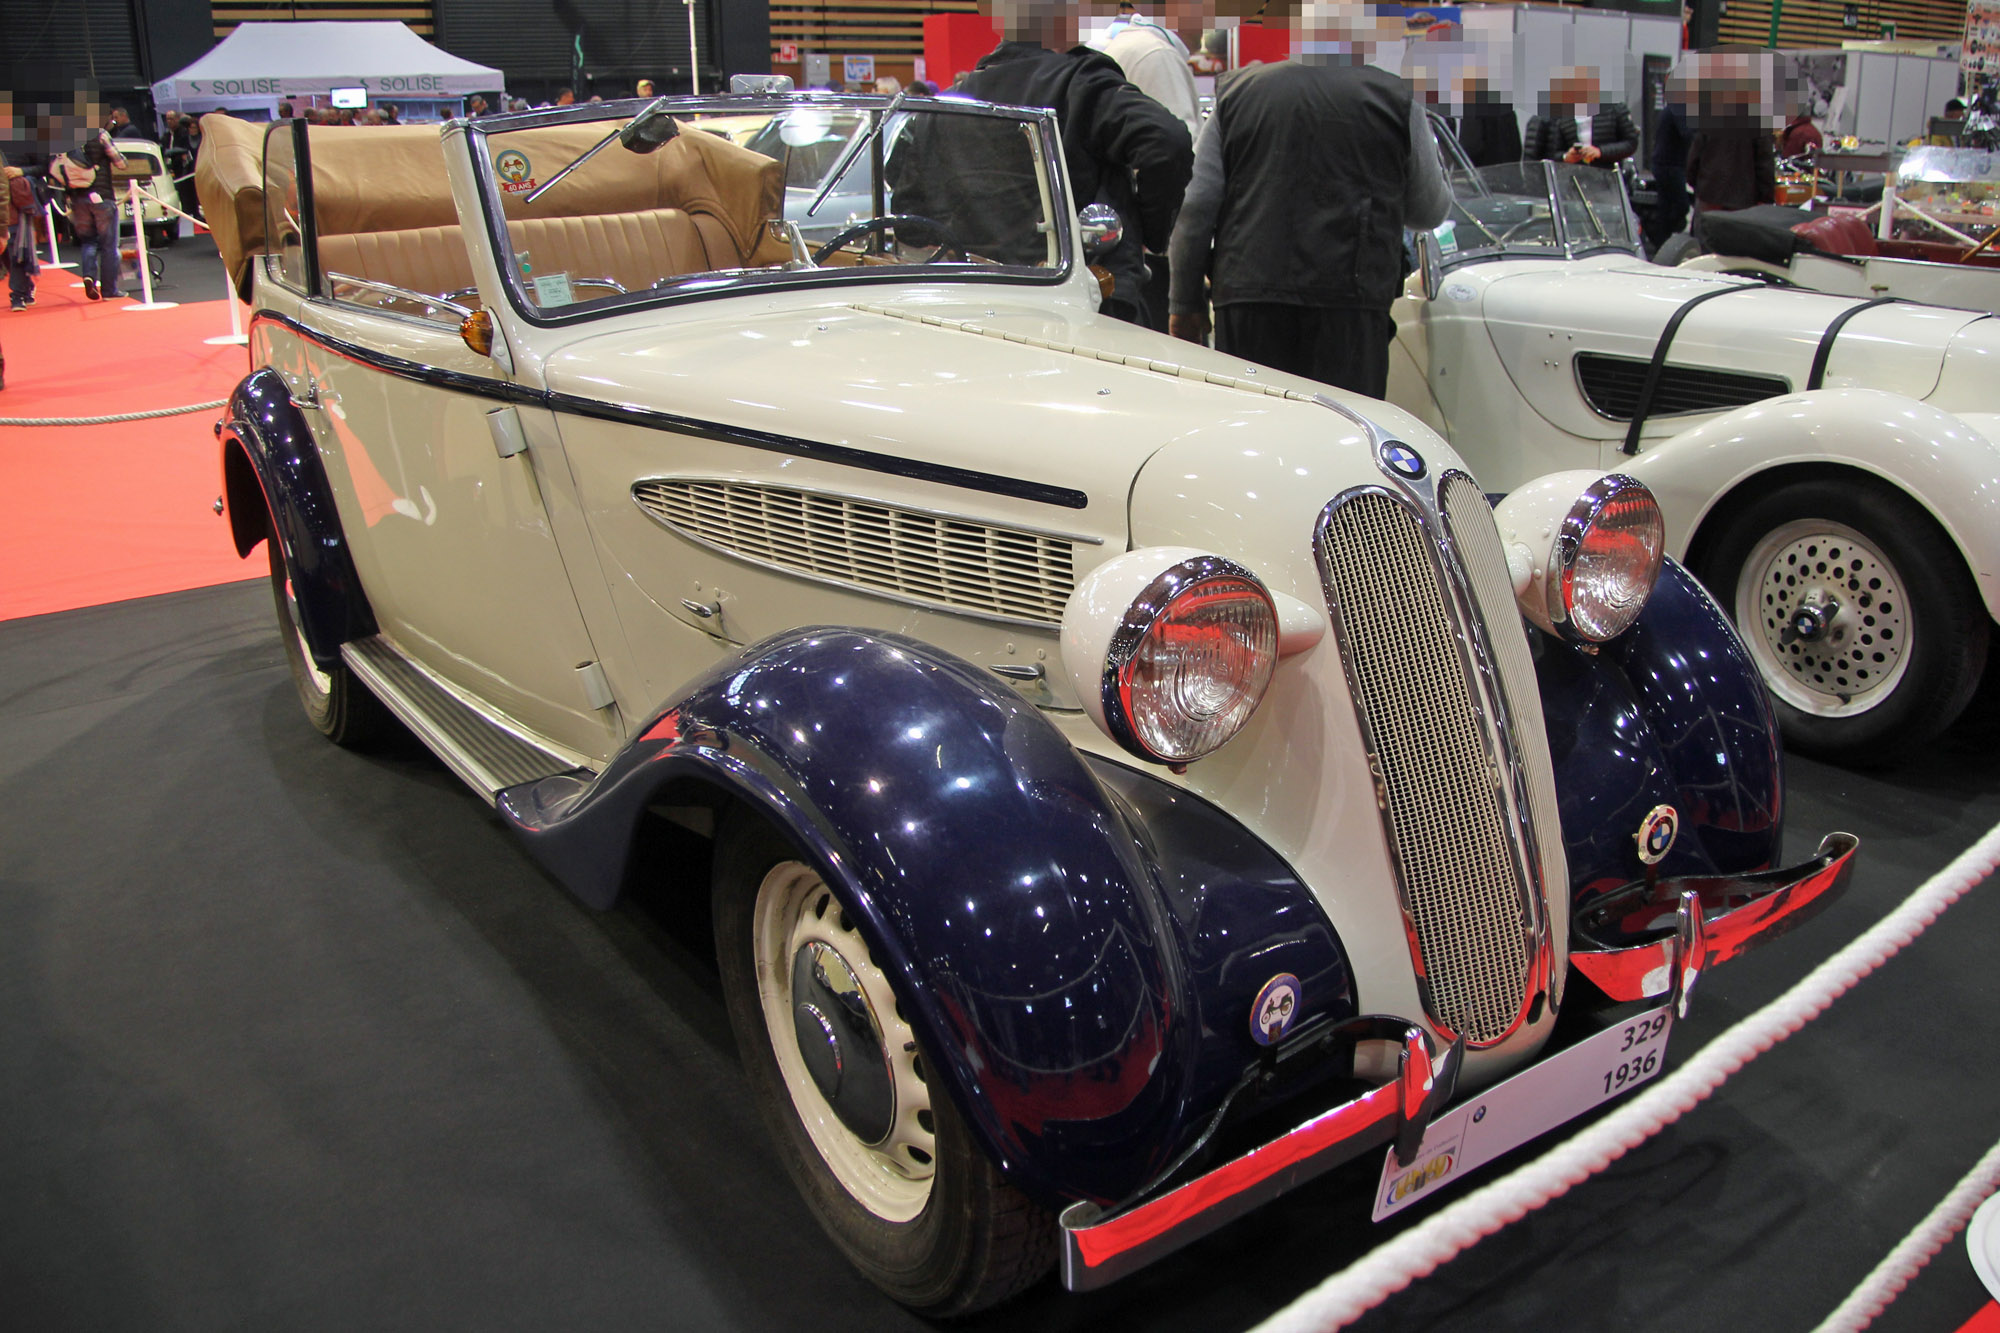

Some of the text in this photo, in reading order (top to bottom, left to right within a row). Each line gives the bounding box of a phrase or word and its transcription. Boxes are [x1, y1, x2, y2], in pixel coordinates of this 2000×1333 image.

[212, 78, 283, 95] SOLISE
[380, 76, 444, 92] SOLISE
[518, 181, 532, 190] ANS
[1620, 1014, 1667, 1052] 329
[1604, 1048, 1657, 1094] 1936
